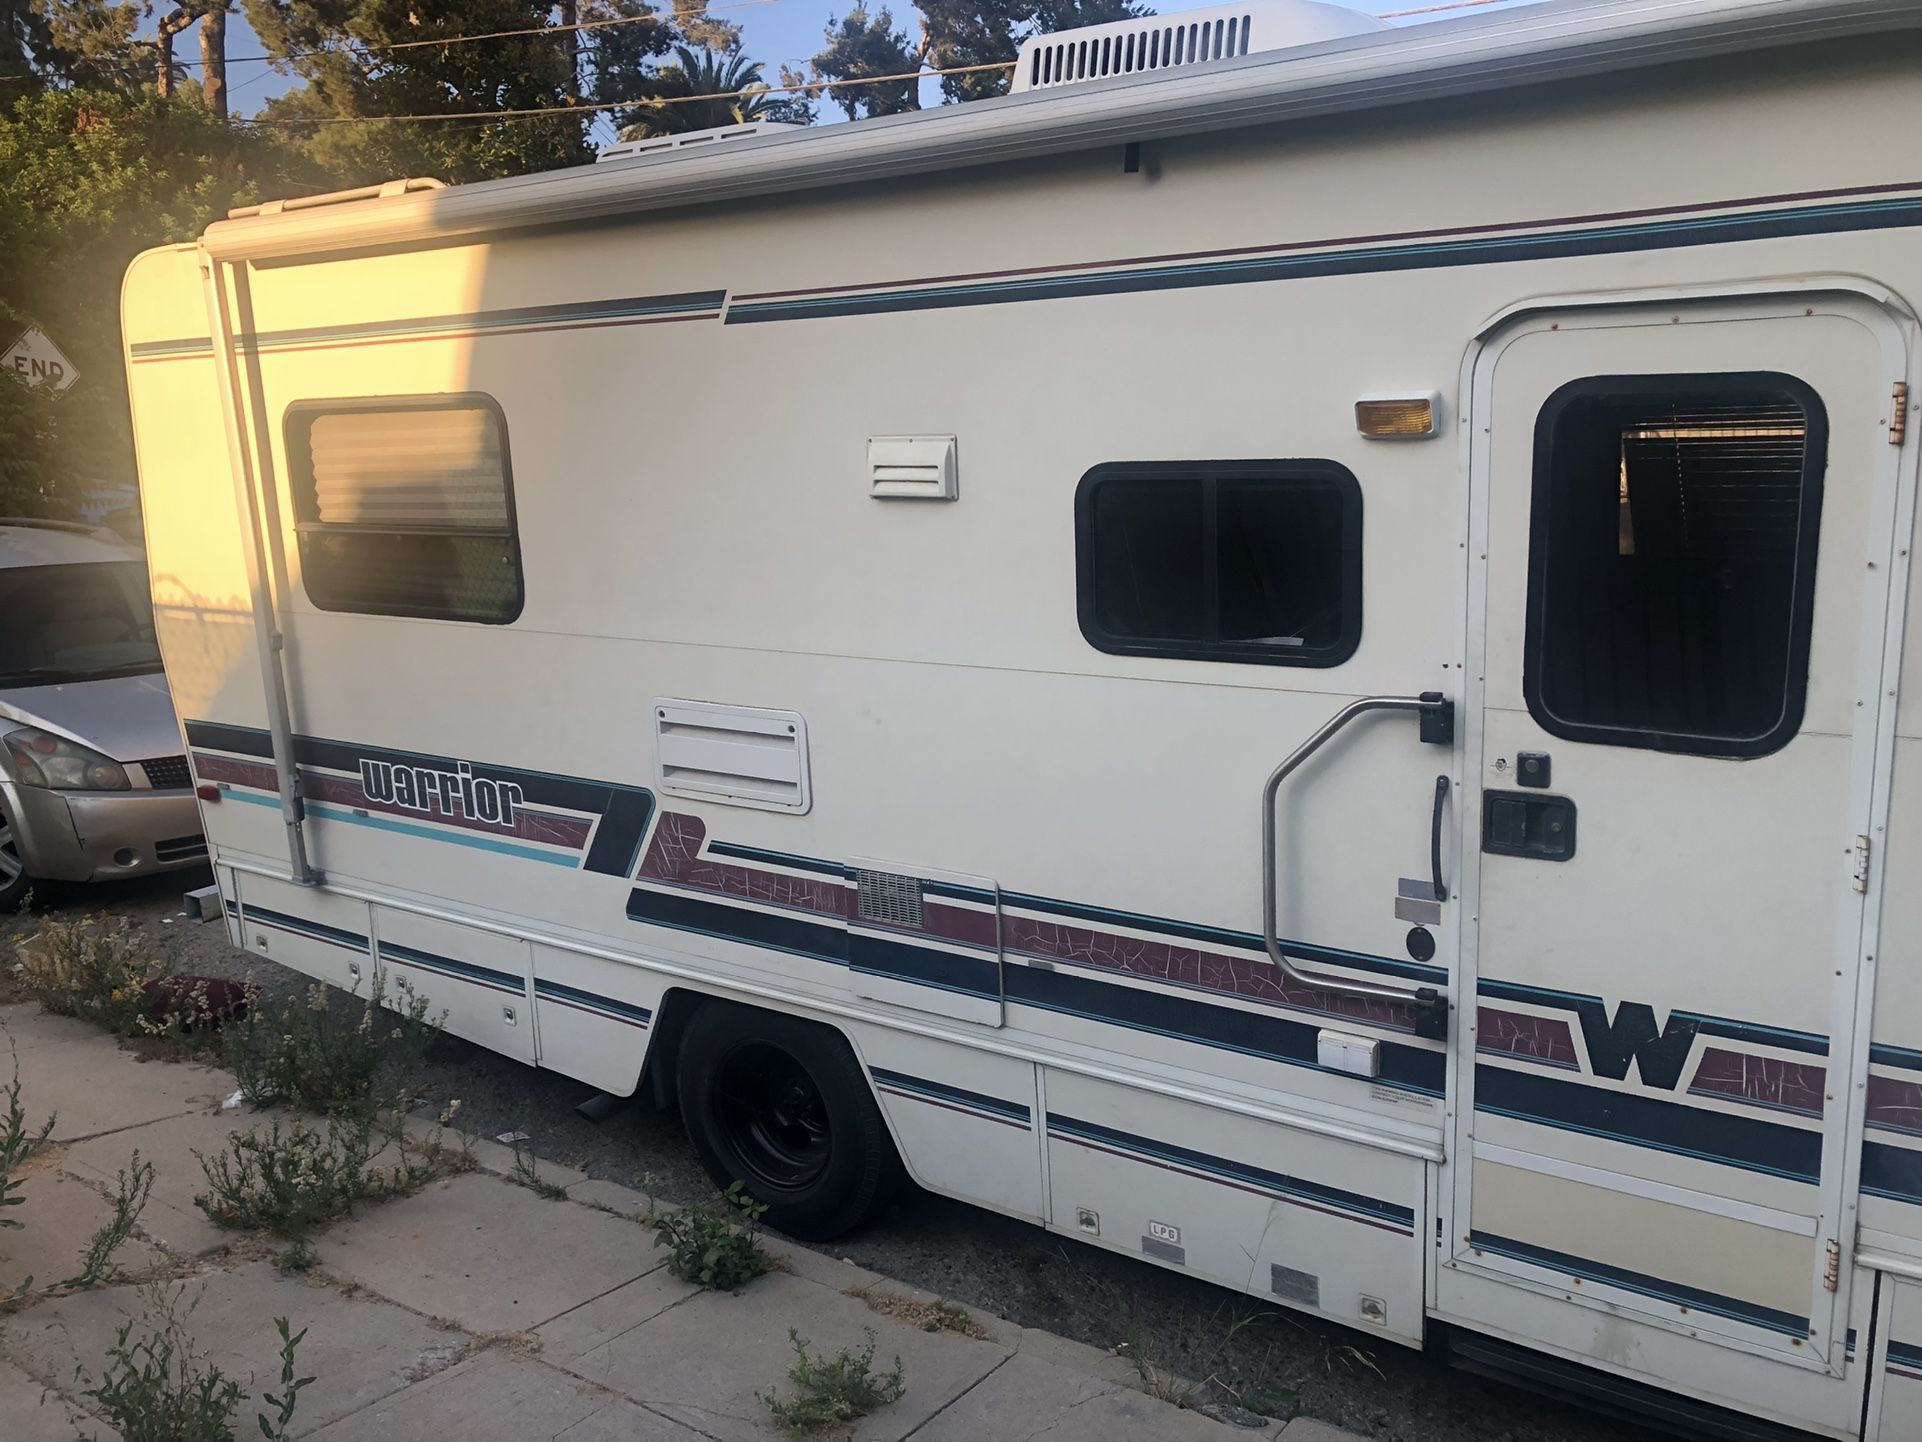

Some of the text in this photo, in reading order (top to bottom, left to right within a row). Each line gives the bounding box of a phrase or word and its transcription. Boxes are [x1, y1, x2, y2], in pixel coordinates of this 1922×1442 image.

[14, 355, 64, 382] END
[359, 758, 523, 827] warrior
[1577, 1000, 1700, 1092] W
[1152, 1223, 1176, 1240] LPG
